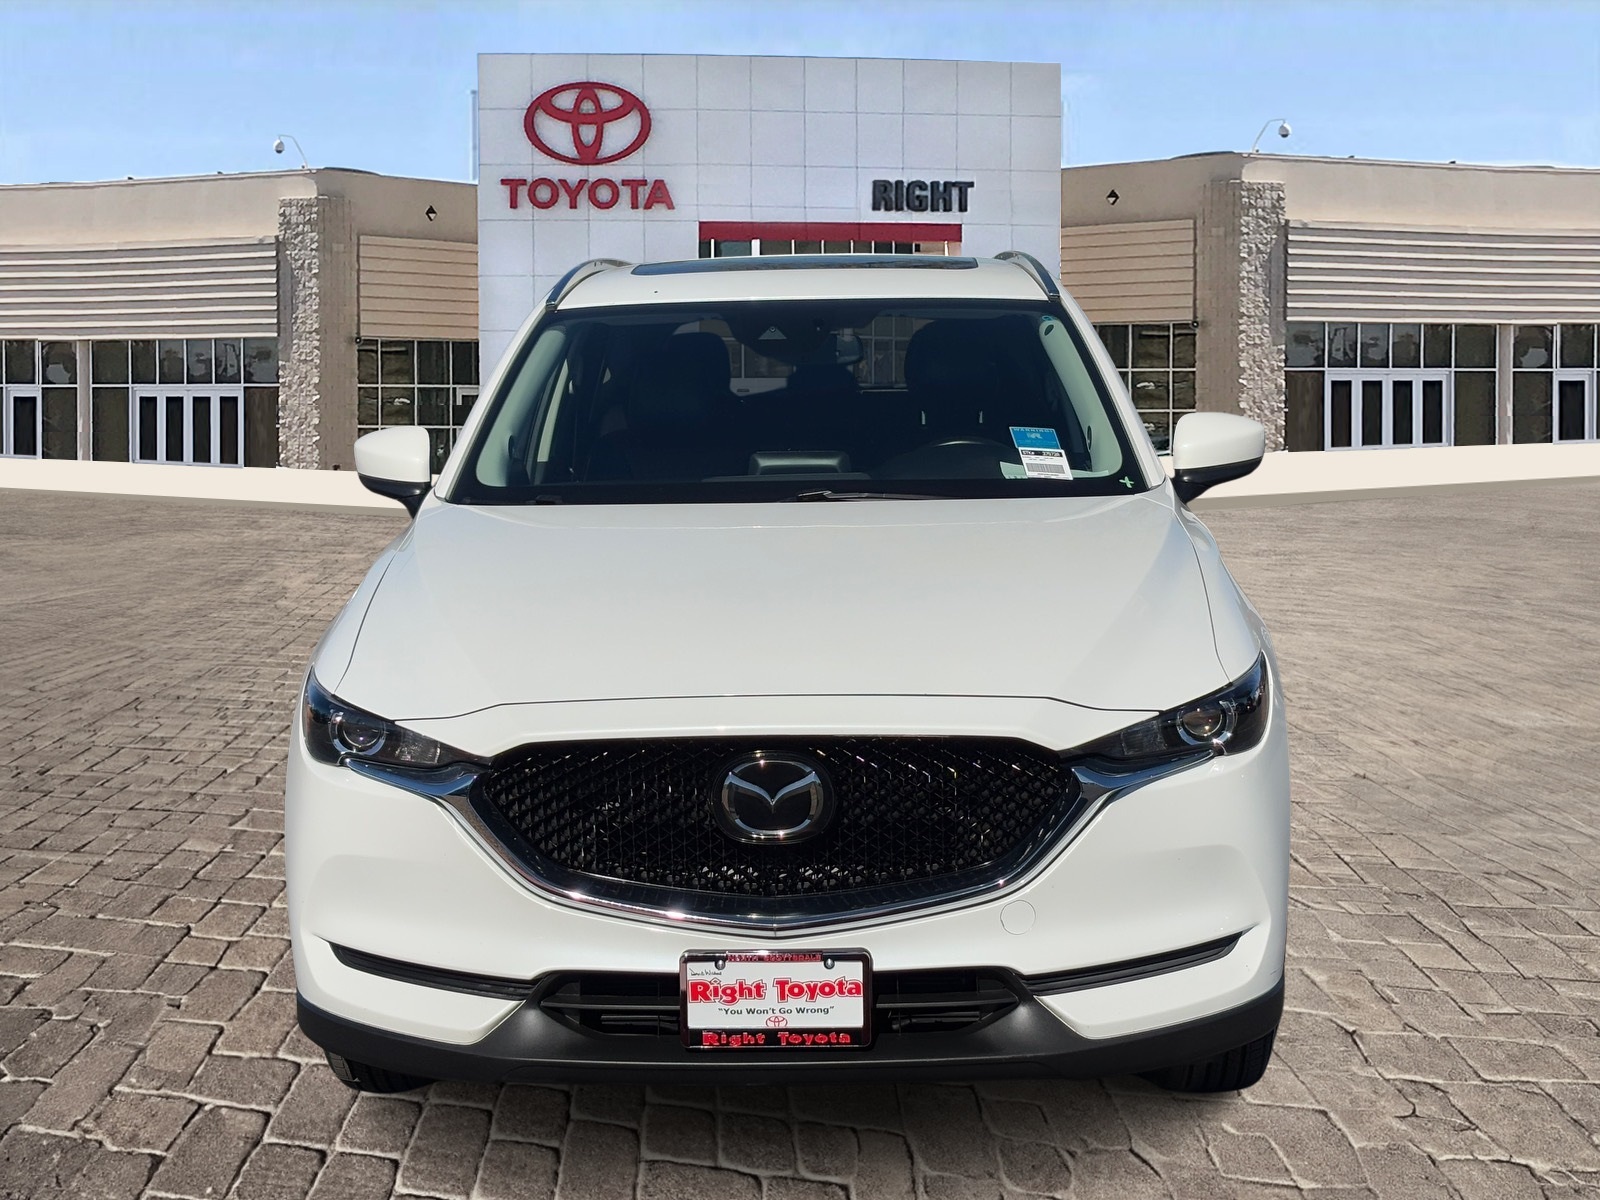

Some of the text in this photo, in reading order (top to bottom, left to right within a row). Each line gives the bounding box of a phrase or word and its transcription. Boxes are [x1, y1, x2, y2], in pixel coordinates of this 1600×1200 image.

[501, 178, 675, 210] TOYOTA
[872, 179, 975, 213] RIGHT
[688, 977, 863, 1005] Right Toyota
[746, 1007, 776, 1015] Won’t
[778, 1007, 793, 1015] Go
[702, 1031, 851, 1047] Right Toyota
